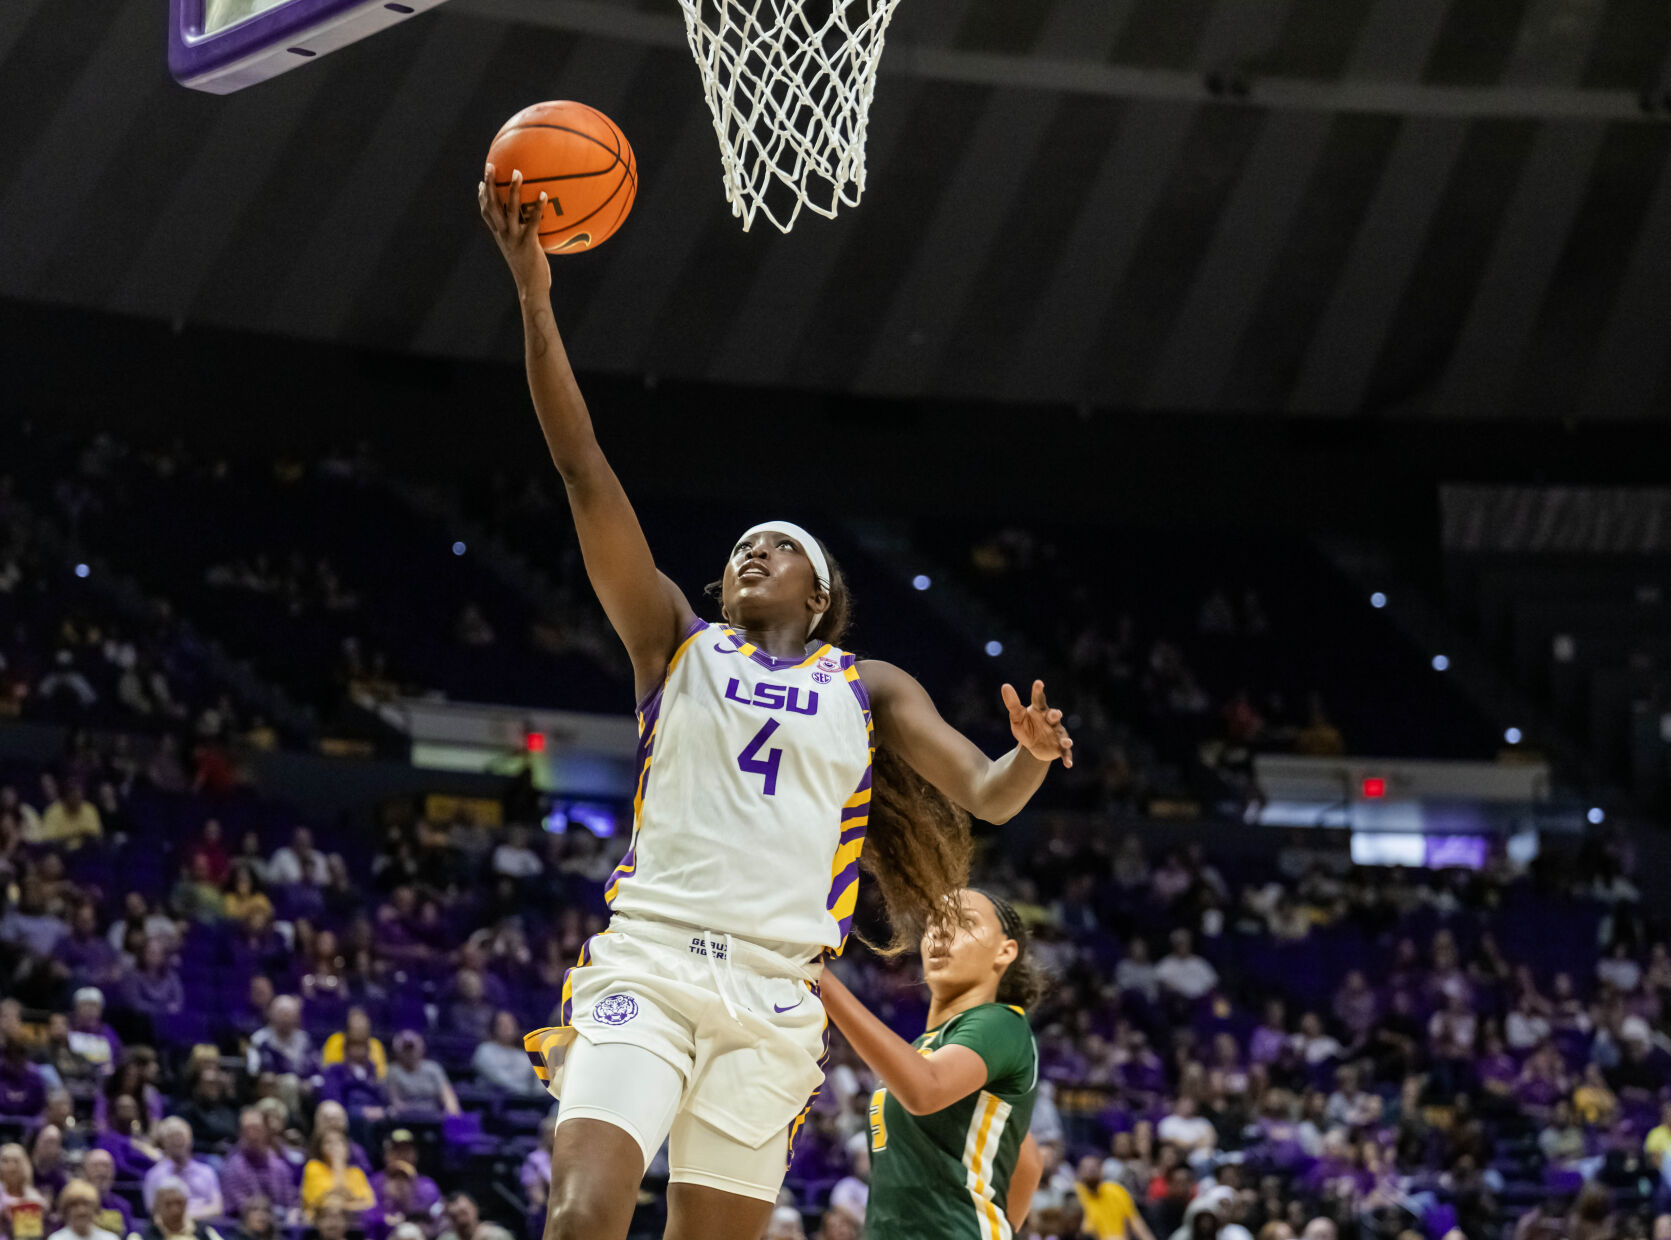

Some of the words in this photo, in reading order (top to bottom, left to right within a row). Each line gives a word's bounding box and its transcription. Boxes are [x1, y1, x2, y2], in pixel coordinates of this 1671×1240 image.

[725, 677, 819, 716] LSU
[814, 672, 830, 682] SEC
[737, 717, 783, 796] 4
